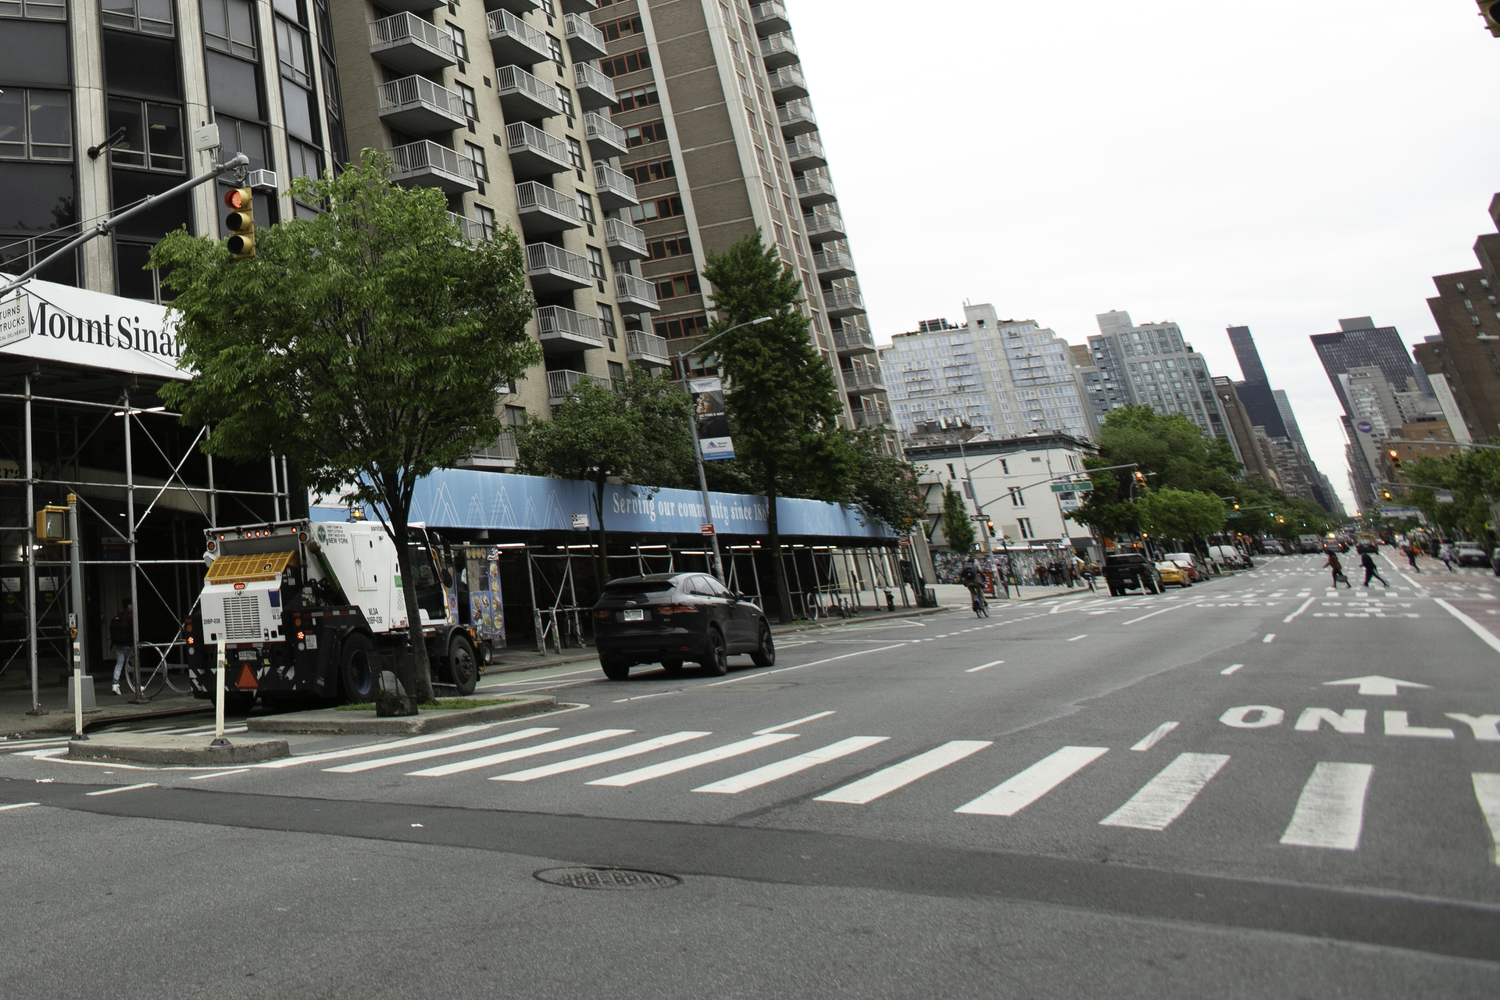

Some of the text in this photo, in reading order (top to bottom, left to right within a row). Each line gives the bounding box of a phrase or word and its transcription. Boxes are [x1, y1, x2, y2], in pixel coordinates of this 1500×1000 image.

[0, 305, 21, 320] TURNS
[0, 316, 26, 333] TRUCKS
[30, 302, 182, 358] Mount Sinai
[613, 492, 654, 522] Serving
[658, 502, 675, 516] our
[678, 500, 729, 526] commnity
[731, 501, 753, 520] since
[1219, 704, 1500, 741] ONLY
